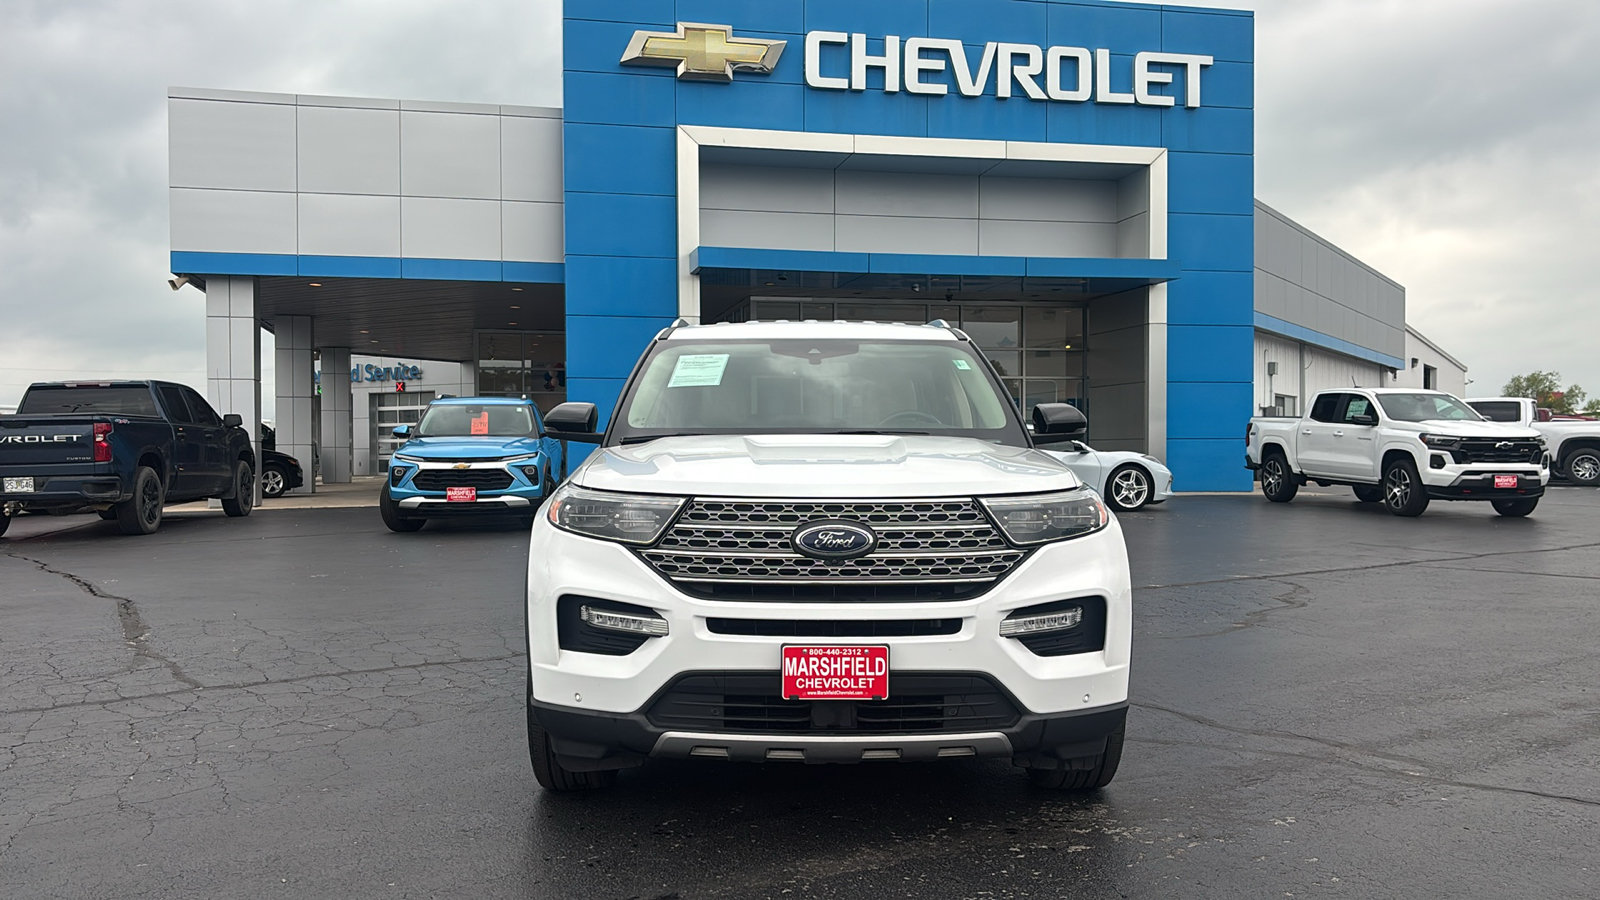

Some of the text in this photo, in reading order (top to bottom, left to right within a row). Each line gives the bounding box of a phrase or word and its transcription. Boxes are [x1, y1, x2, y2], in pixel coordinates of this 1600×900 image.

[805, 30, 1213, 108] CHEVROLET
[365, 362, 420, 381] Service
[814, 530, 856, 548] Ford
[785, 657, 886, 676] MARSHFIELD
[796, 678, 875, 688] CHEVROLET
